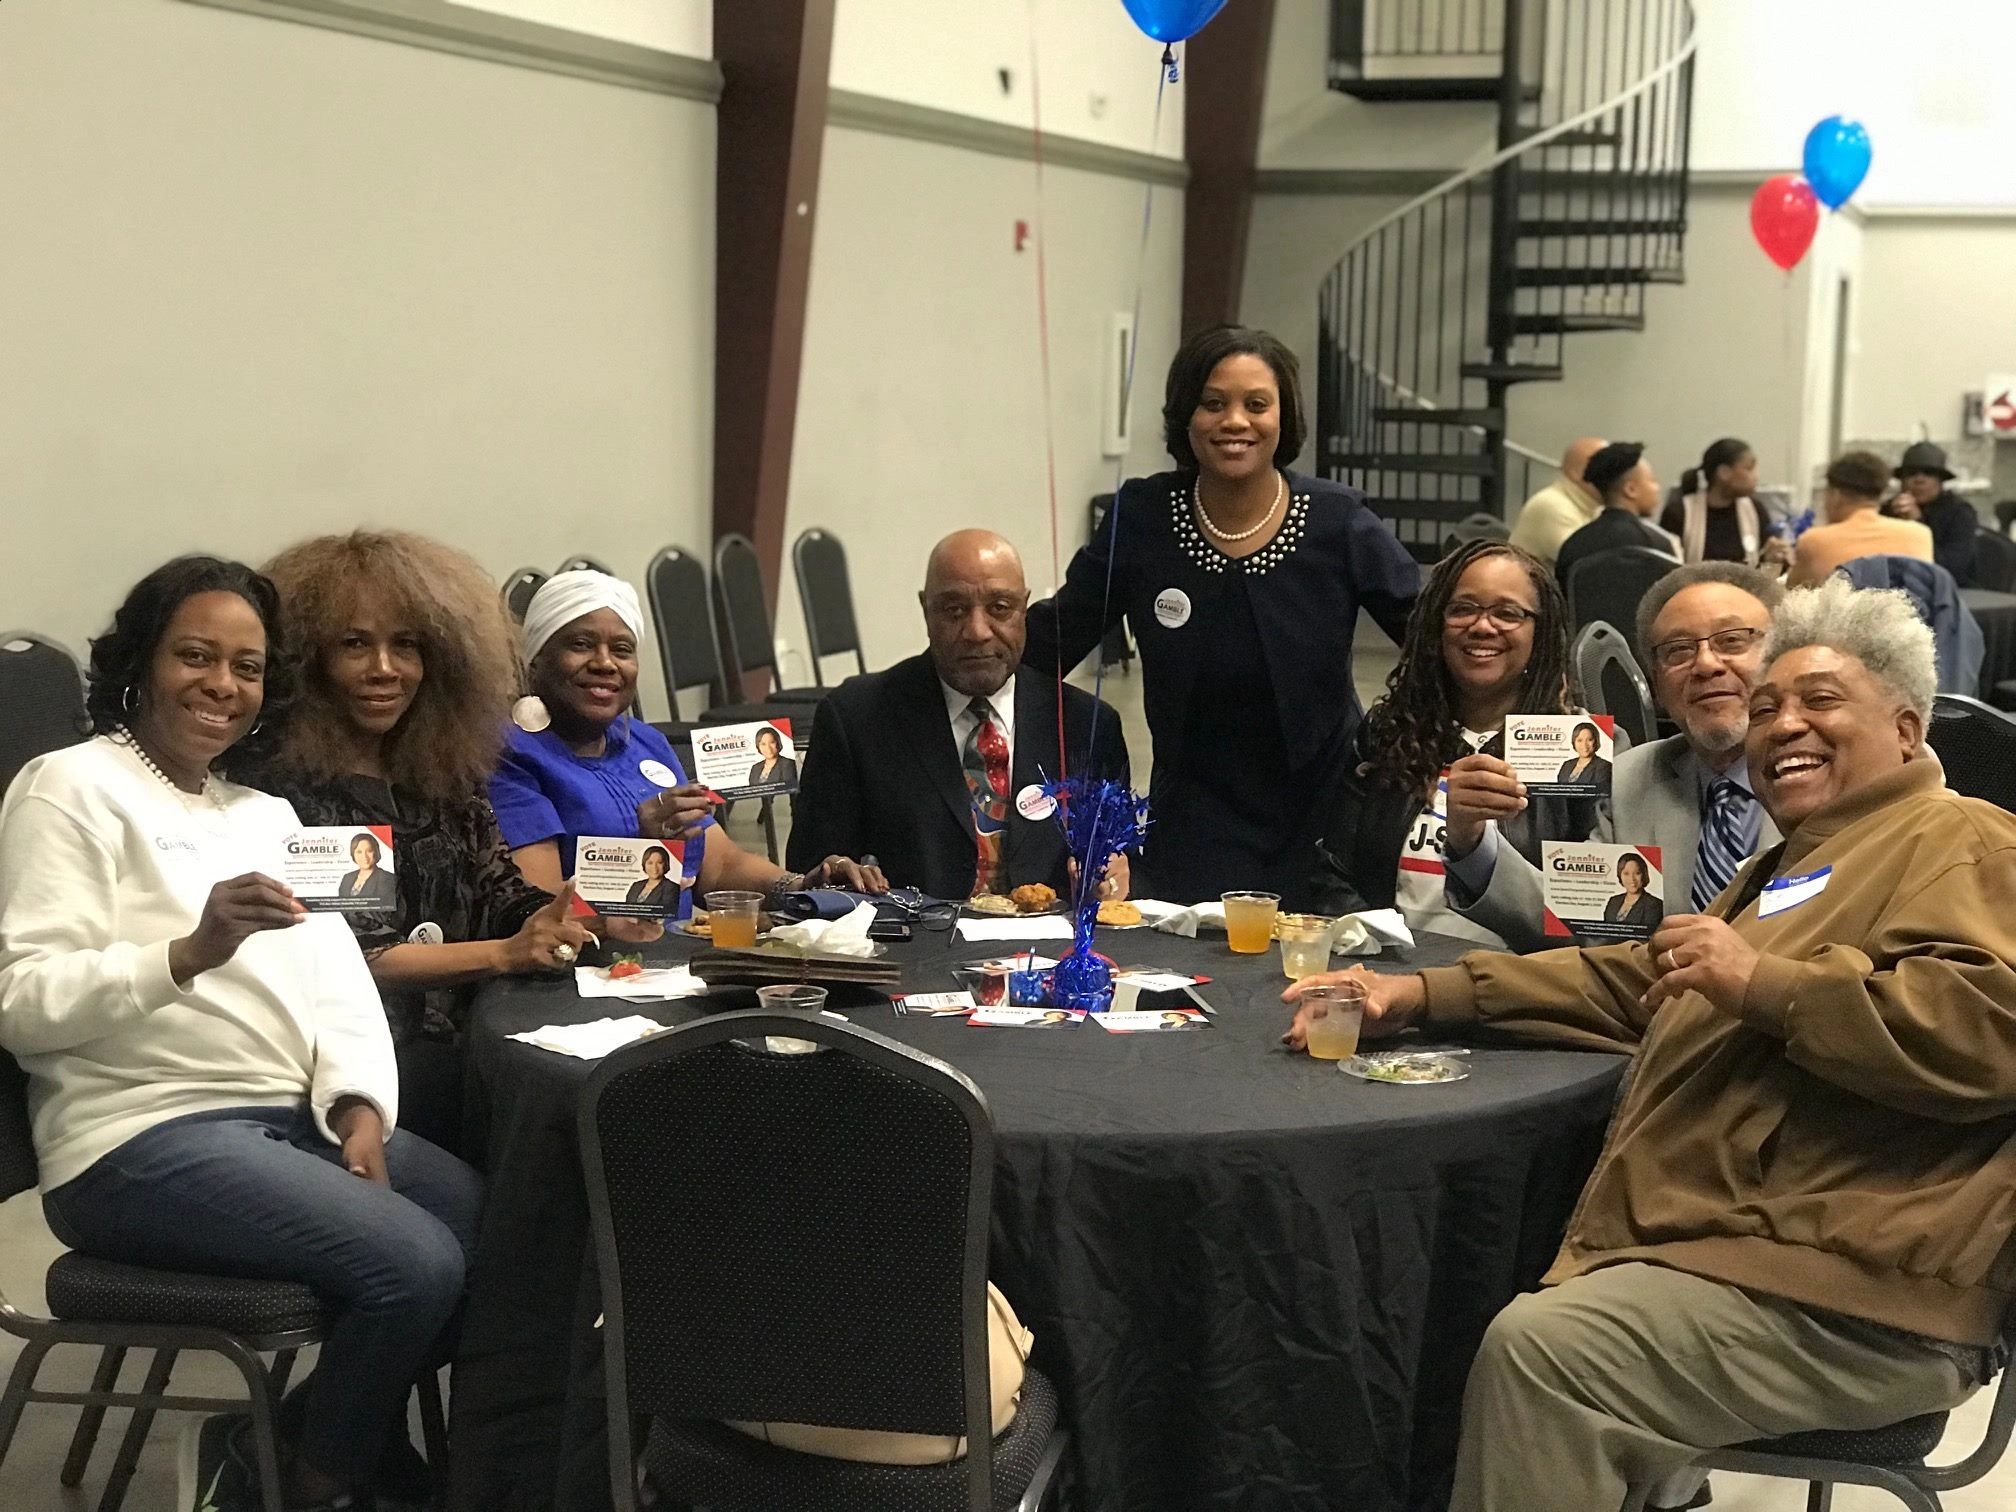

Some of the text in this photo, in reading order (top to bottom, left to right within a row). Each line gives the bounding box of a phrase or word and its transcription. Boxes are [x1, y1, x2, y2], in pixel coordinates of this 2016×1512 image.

[1514, 729, 1561, 741] GAMBLE
[702, 740, 746, 752] GAMBLE
[287, 842, 340, 854] GAMBLE
[1547, 848, 1564, 859] VOTE
[585, 850, 632, 863] GAMBLE
[1552, 858, 1605, 873] GAMBLE
